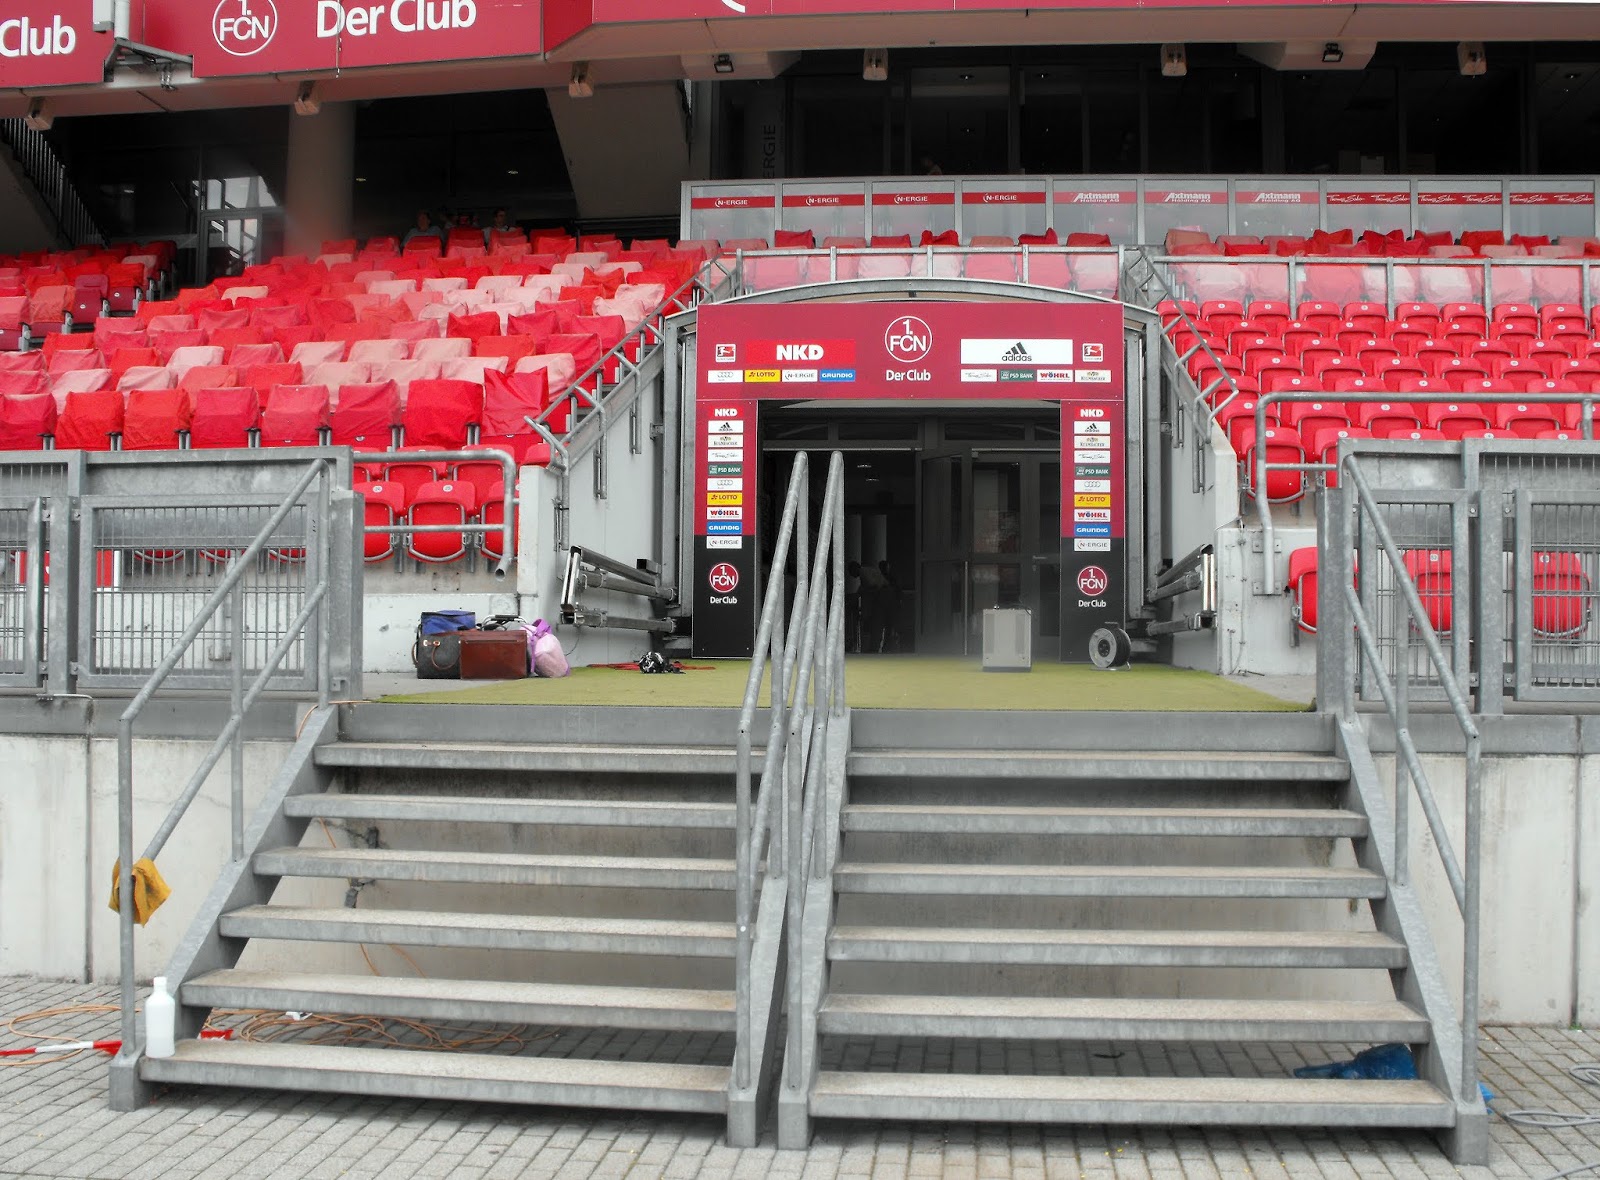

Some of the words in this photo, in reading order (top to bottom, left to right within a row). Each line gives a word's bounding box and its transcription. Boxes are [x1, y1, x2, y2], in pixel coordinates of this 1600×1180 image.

[316, 0, 385, 38] Der
[390, 0, 477, 32] Club
[220, 15, 270, 41] FCN
[0, 14, 76, 58] Club
[903, 319, 913, 334] 1.
[890, 335, 927, 351] FCN
[776, 344, 824, 361] NKD
[886, 369, 905, 381] Der
[906, 368, 931, 381] Club
[714, 408, 738, 417] NKD
[1080, 409, 1104, 418] NKD
[720, 566, 728, 575] 1.
[1088, 568, 1096, 578] 1.
[712, 575, 735, 586] FCN
[1080, 578, 1104, 589] FCN
[710, 596, 722, 604] Der
[722, 596, 738, 604] Club
[1078, 599, 1090, 608] Der
[1091, 599, 1107, 608] Club
